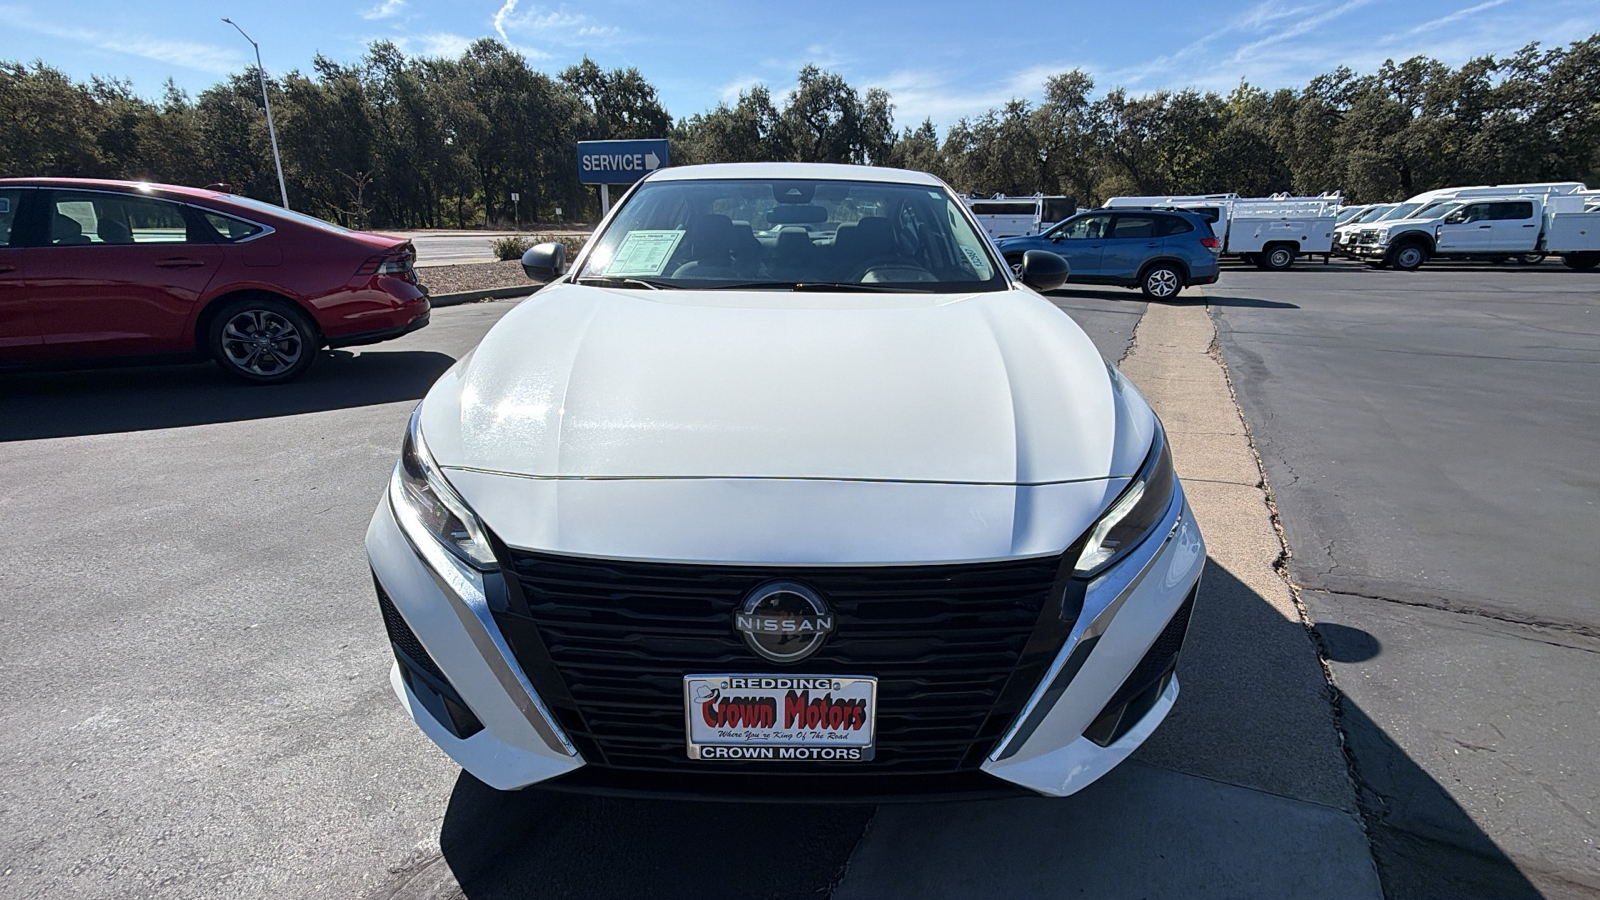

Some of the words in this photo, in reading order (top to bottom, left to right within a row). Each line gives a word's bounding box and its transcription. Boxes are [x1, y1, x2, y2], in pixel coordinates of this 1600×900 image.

[582, 154, 643, 171] SERVICE
[738, 616, 831, 631] NISSAN
[732, 678, 830, 689] REDDING
[702, 688, 777, 729] Crown
[784, 690, 867, 730] Motors
[718, 730, 743, 738] Where
[744, 730, 771, 741] You're
[773, 731, 793, 740] King
[796, 731, 806, 741] Of
[810, 731, 824, 739] The
[827, 732, 850, 740] Road
[702, 747, 773, 758] CROWN
[780, 748, 861, 760] MOTORS
